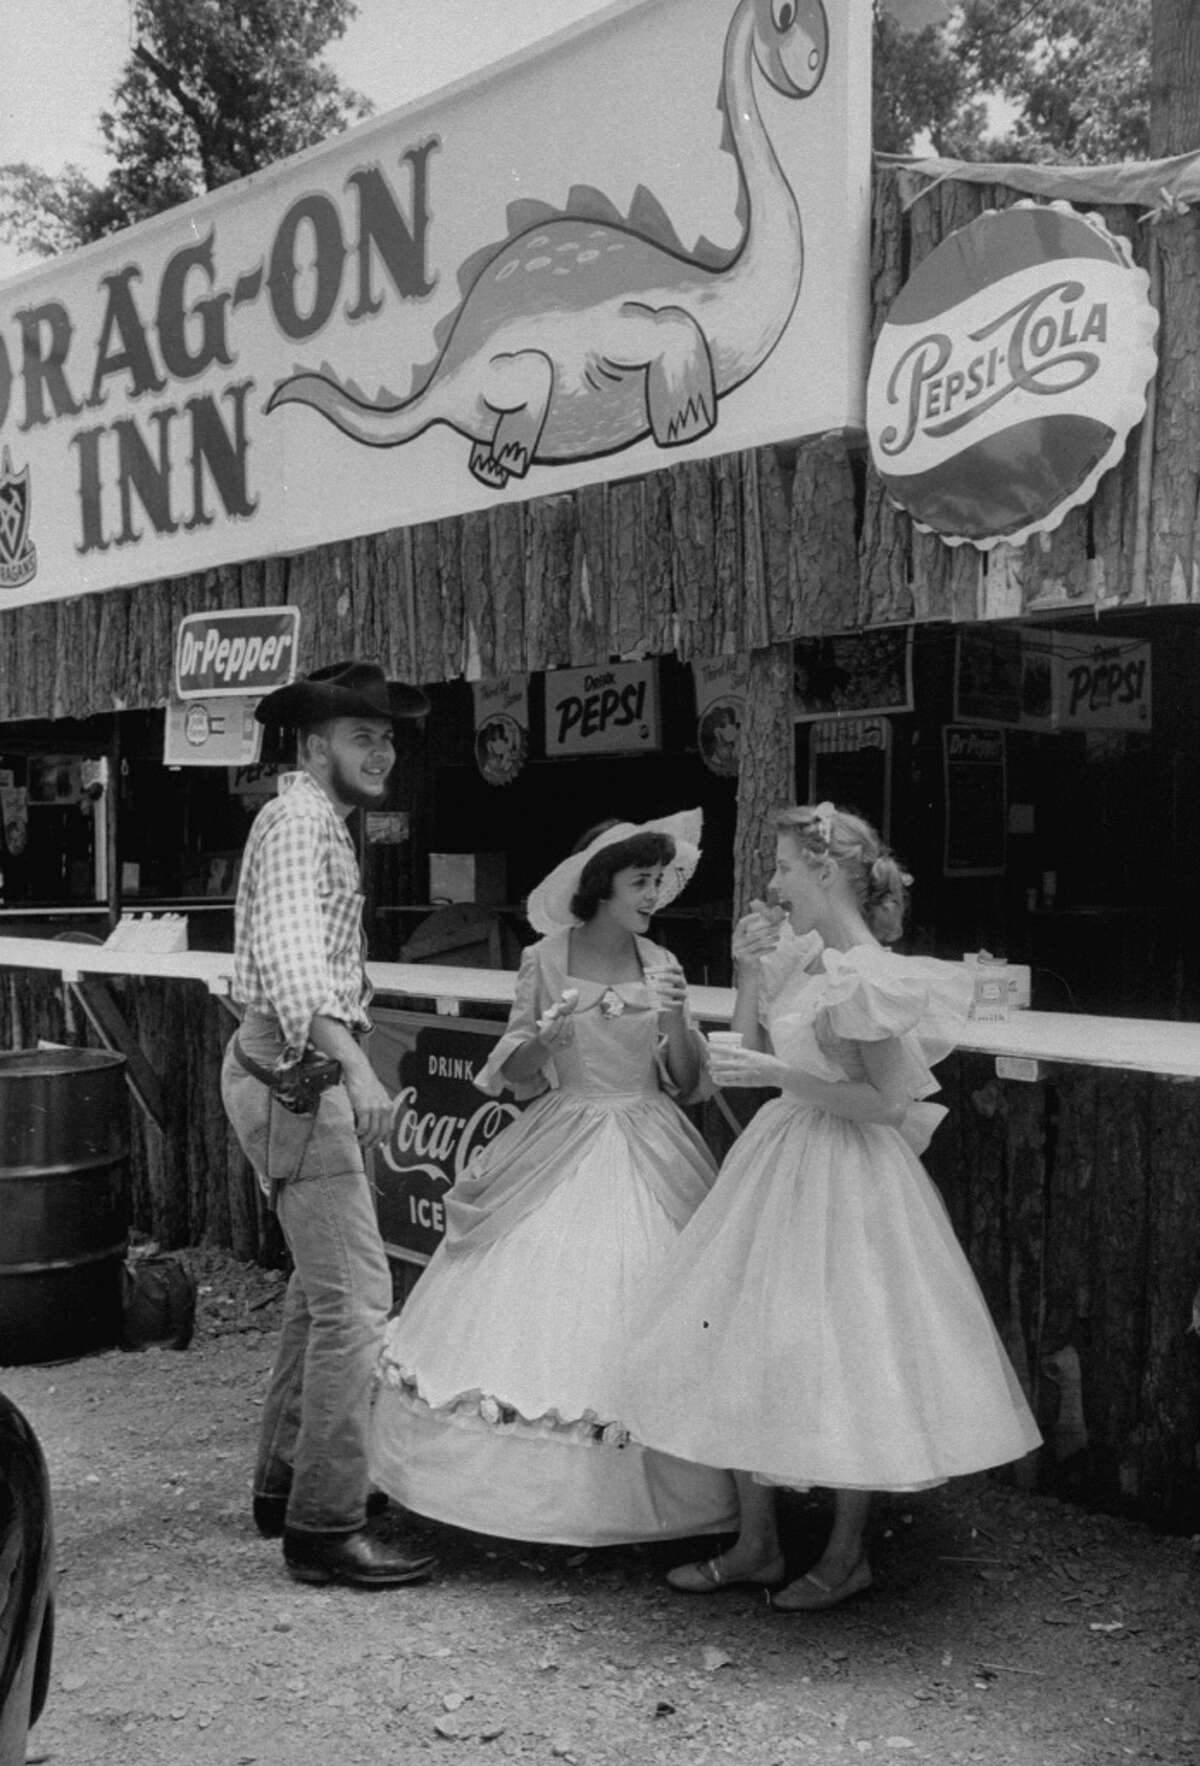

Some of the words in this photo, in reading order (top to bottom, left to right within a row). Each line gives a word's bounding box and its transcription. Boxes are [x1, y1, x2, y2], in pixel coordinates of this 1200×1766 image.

[0, 136, 441, 432] RAG-ON
[69, 380, 259, 554] INN
[556, 681, 646, 743] PEPSI
[428, 1055, 475, 1081] DRINK
[409, 1195, 445, 1232] ICE
